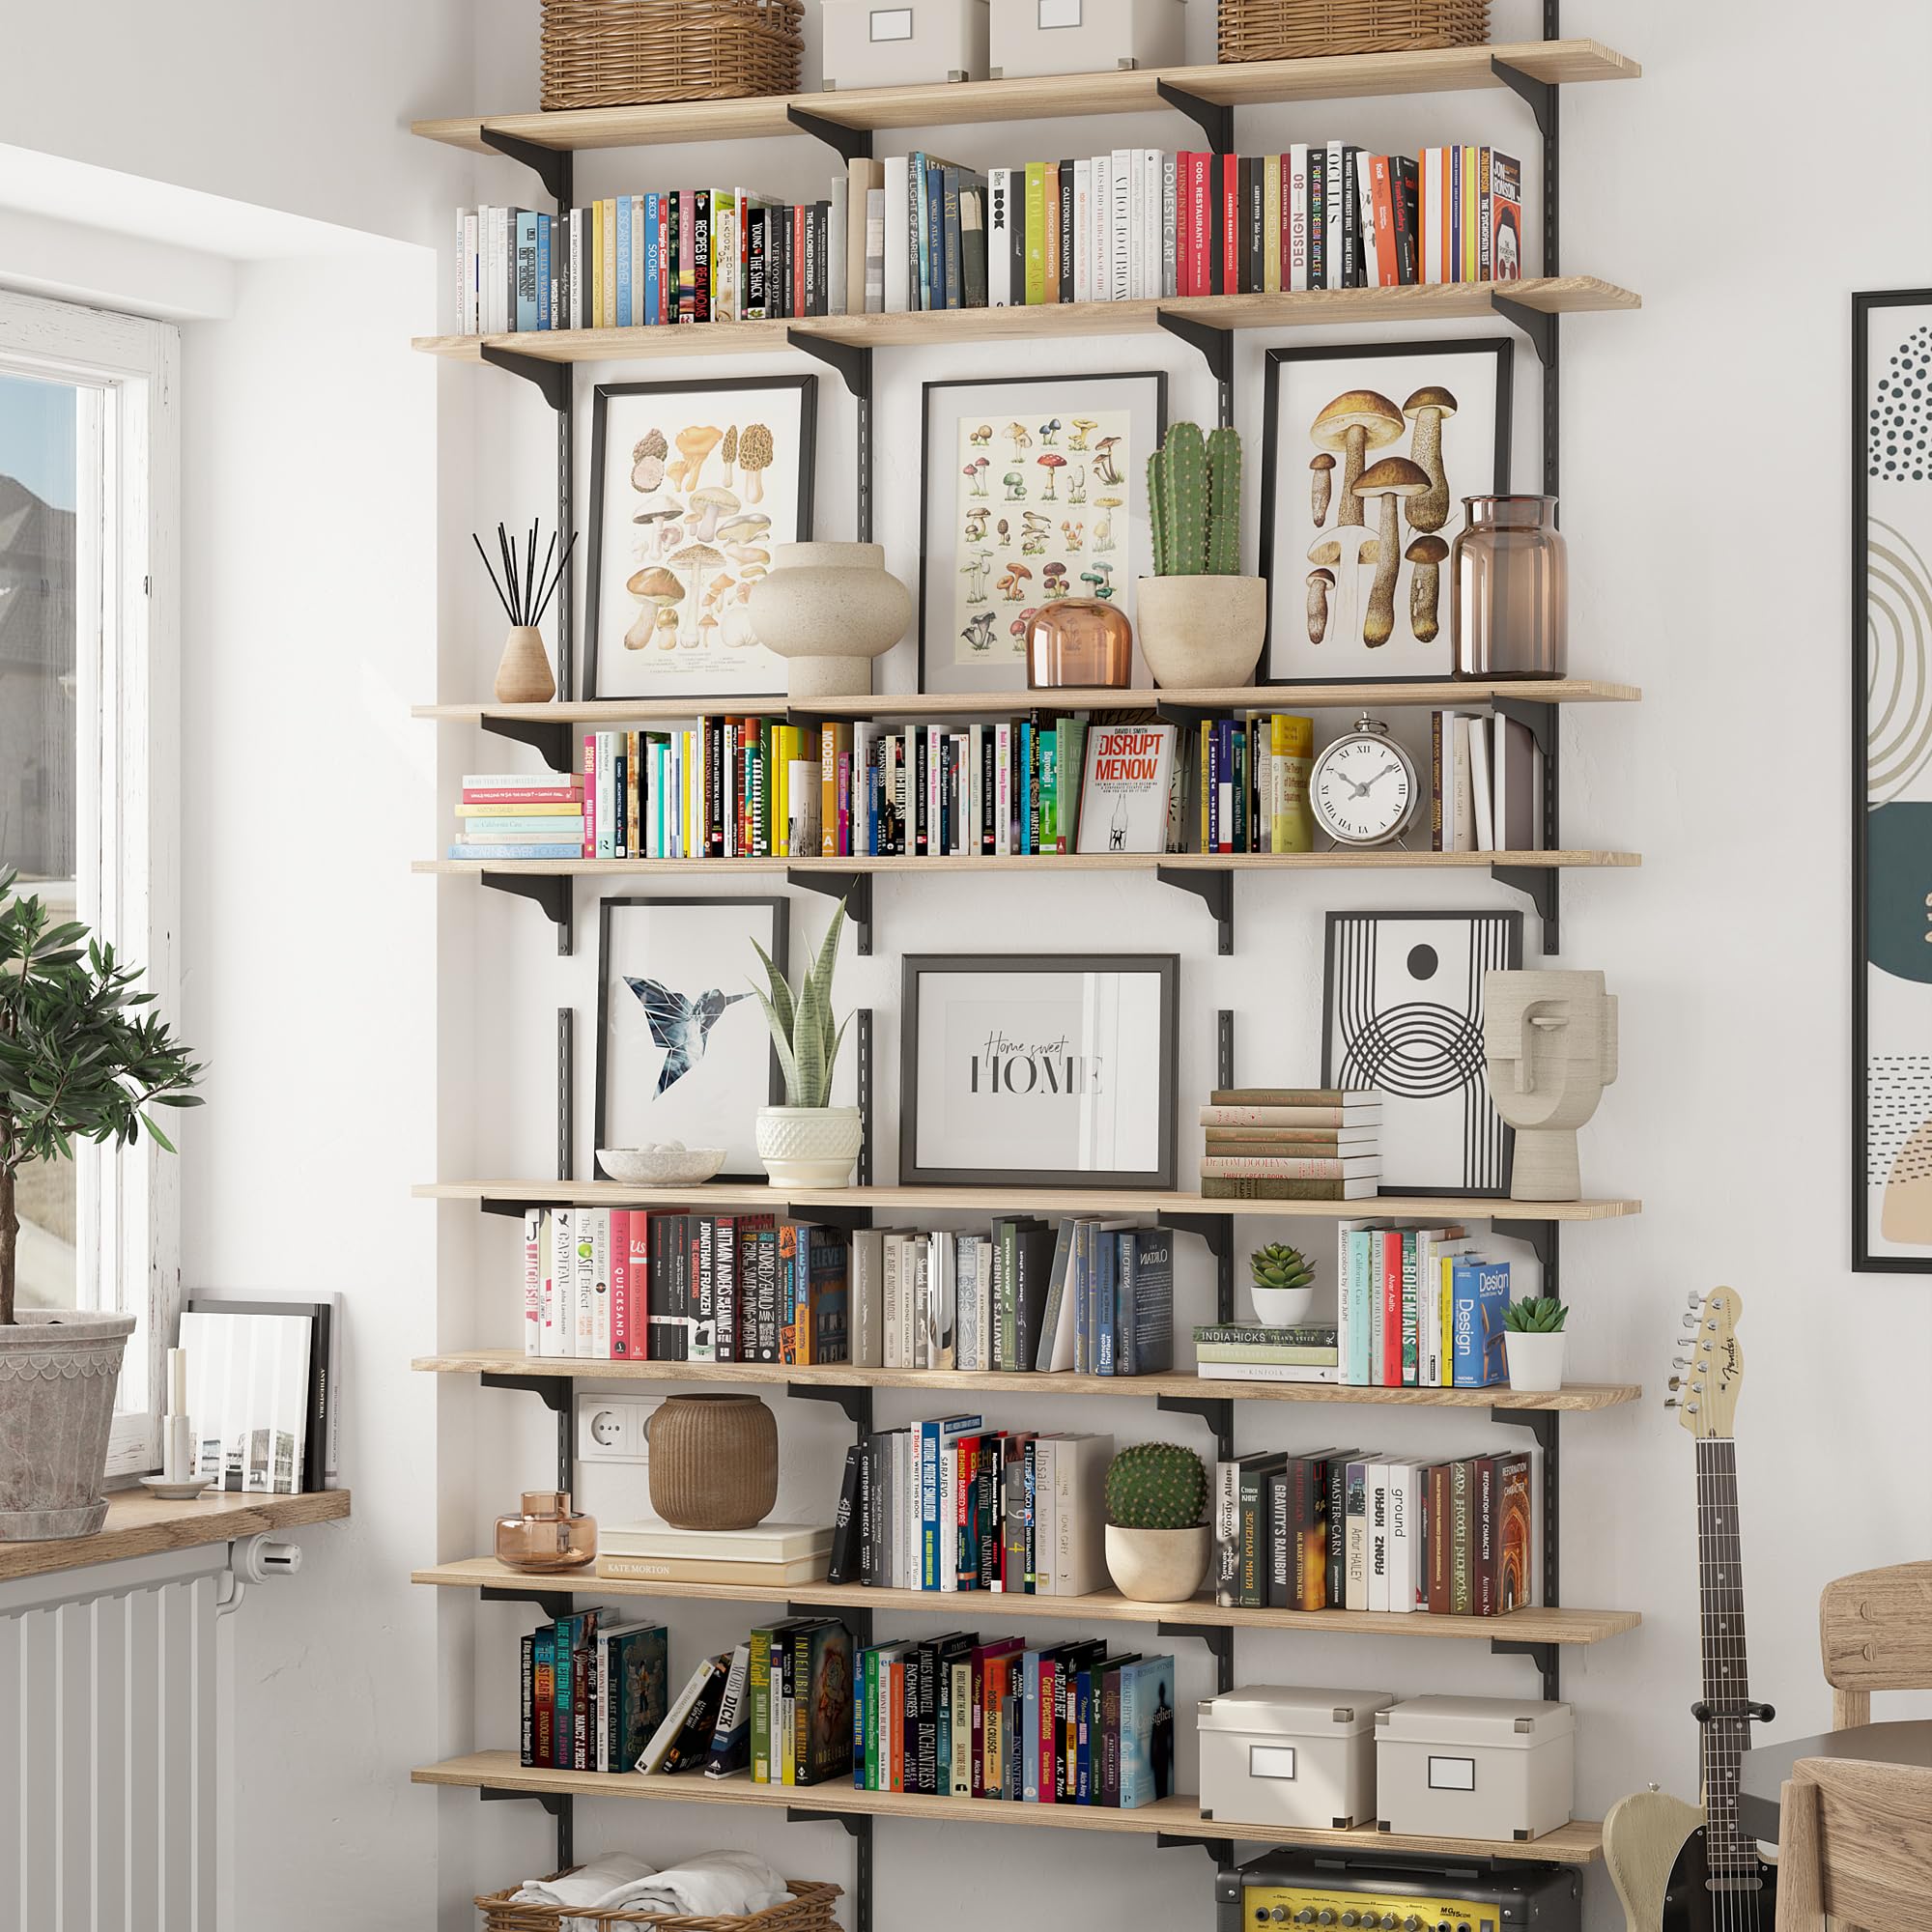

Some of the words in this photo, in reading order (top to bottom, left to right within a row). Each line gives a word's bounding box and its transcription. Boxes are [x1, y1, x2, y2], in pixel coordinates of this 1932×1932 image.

[1293, 174, 1304, 189] 80
[1328, 154, 1341, 224] OCULUS
[946, 192, 956, 220] ART
[994, 189, 1005, 229] BOOK
[1116, 177, 1127, 218] FOLLY
[1164, 163, 1175, 234] DOMESTIC
[696, 220, 707, 252] RECIPES
[753, 223, 763, 247] YOUNG
[910, 214, 917, 228] OF
[1164, 240, 1175, 264] ART
[1293, 213, 1304, 267] DESIGN
[696, 255, 707, 266] BY
[696, 267, 706, 287] REAL
[752, 271, 765, 298] SHACK
[696, 290, 706, 317] MOMS
[823, 731, 833, 781] MODERN
[1098, 734, 1163, 755] DISRUPT
[1095, 758, 1157, 780] MENOW
[1262, 753, 1270, 777] AFTER
[1262, 781, 1270, 802] DAYS
[1324, 801, 1337, 819] VIII
[1338, 818, 1351, 832] VII
[984, 1031, 1025, 1067] Home
[1030, 1036, 1069, 1065] sweet
[967, 1056, 1103, 1094] HOME
[1206, 1158, 1218, 1167] Dr.
[1220, 1158, 1240, 1168] TOM
[1243, 1158, 1289, 1168] DOOLEY'S
[558, 1233, 569, 1287] CAPITAL
[700, 1222, 711, 1269] JONATHAN
[718, 1228, 732, 1262] HITMAN
[888, 1245, 896, 1256] WE
[718, 1264, 732, 1295] ANDERS
[888, 1259, 896, 1272] ARE
[917, 1258, 927, 1286] Sherlock
[581, 1278, 591, 1308] Effect
[700, 1271, 711, 1316] FRANZEN
[1479, 1270, 1509, 1295] Design
[887, 1275, 896, 1321] ANONYMOUS
[917, 1288, 927, 1310] Holmes
[1403, 1265, 1416, 1345] BOHEMIANS
[742, 1318, 756, 1349] SWEDEN
[1202, 1331, 1231, 1342] INDIA
[1234, 1332, 1266, 1343] HICKS
[1455, 1299, 1474, 1356] Design
[1720, 1337, 1739, 1381] Fender
[923, 1437, 936, 1461] VIRTUAL
[923, 1463, 936, 1486] PATIENT
[1037, 1450, 1050, 1492] Unsaid
[1224, 1469, 1233, 1497] Allen
[923, 1487, 936, 1521] SIMULATION
[979, 1475, 988, 1510] MAXWELL
[1332, 1478, 1341, 1519] MASTER
[1375, 1488, 1384, 1527] KAFKA
[1223, 1500, 1234, 1538] Woody
[1275, 1485, 1288, 1535] GRAVITY'S
[1391, 1489, 1406, 1538] ground
[1245, 1510, 1255, 1557] ЗЕЛЕНАЯ
[1332, 1525, 1341, 1555] CARN
[1352, 1528, 1362, 1549] Arthur
[608, 1564, 630, 1573] KATE
[632, 1565, 670, 1576] MORTON
[1275, 1538, 1288, 1585] RAINBOW
[1351, 1553, 1362, 1582] HAILEY
[1375, 1536, 1384, 1576] FRANZ
[1245, 1560, 1255, 1590] МИЛЯ
[557, 1622, 570, 1637] LOVE
[795, 1636, 809, 1701] INDELIBLE
[920, 1650, 933, 1674] JAMES
[538, 1679, 551, 1702] EARTH
[727, 1663, 746, 1693] MOBY
[906, 1663, 917, 1717] ENCHANTRESS
[1043, 1677, 1053, 1696] Great
[1055, 1673, 1066, 1702] DEATH
[1122, 1673, 1133, 1704] RICHARD
[557, 1690, 570, 1710] FRONT
[920, 1675, 933, 1714] MAXWELL
[987, 1690, 996, 1726] ROBINSON
[1105, 1690, 1119, 1725] elegance
[718, 1694, 737, 1728] DICK
[1042, 1696, 1053, 1740] Expectations
[1055, 1703, 1066, 1719] BET
[540, 1711, 549, 1744] RANDOLPH
[576, 1715, 585, 1739] NANCY
[987, 1727, 996, 1753] CRUSOE
[576, 1748, 585, 1770] PRICE
[797, 1731, 807, 1763] METCALF
[919, 1723, 935, 1788] ENCHANTRESS
[1012, 1735, 1021, 1796] ENCHANTRESS
